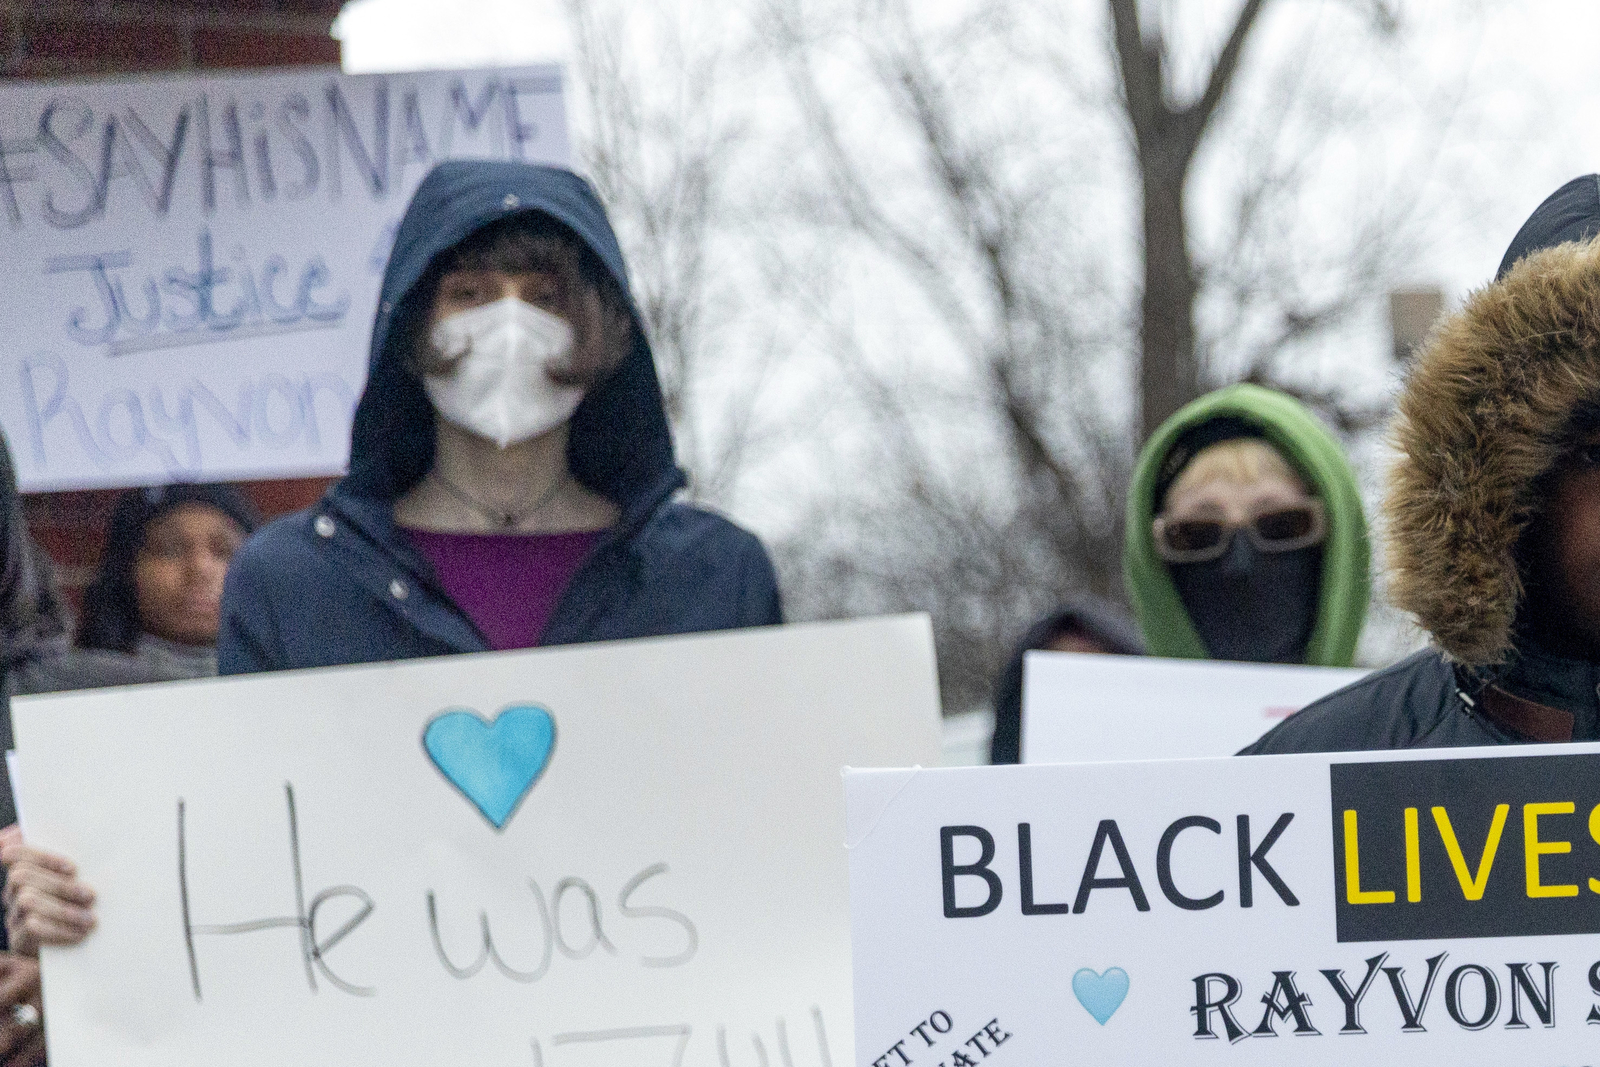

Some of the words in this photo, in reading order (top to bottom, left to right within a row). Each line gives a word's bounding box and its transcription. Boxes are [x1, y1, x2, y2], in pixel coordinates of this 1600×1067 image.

[43, 228, 352, 346] Justice
[176, 780, 377, 1004] He
[426, 861, 699, 983] was
[939, 812, 1300, 919] BLACK
[910, 1010, 954, 1047] TO
[1189, 952, 1556, 1042] RAYVON
